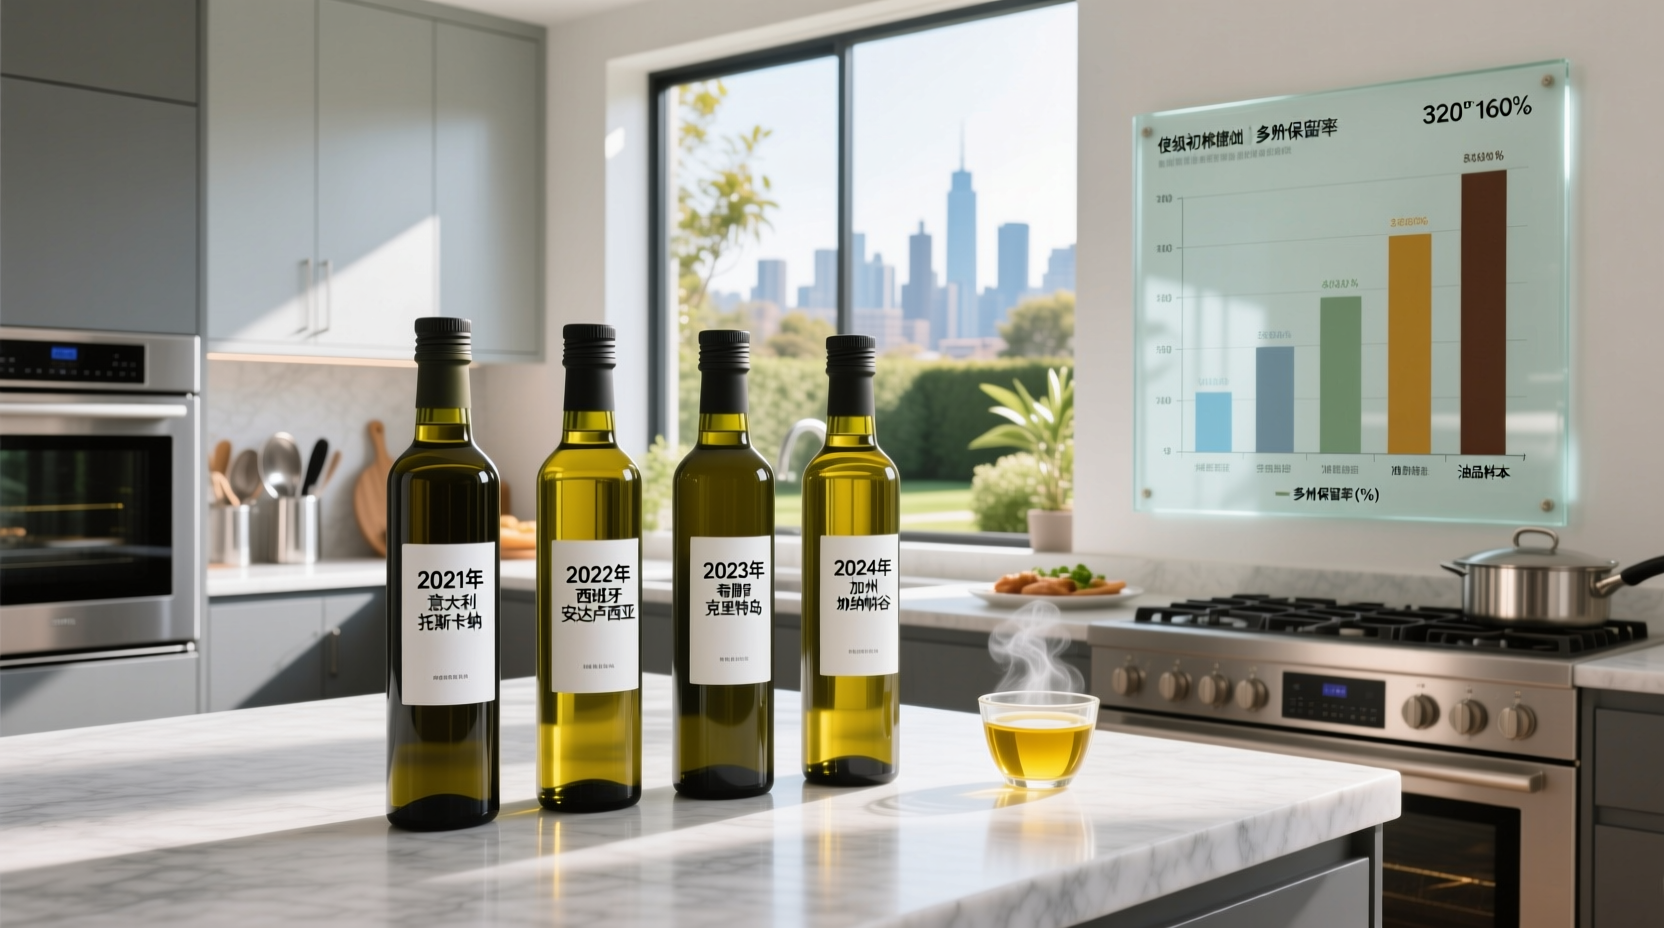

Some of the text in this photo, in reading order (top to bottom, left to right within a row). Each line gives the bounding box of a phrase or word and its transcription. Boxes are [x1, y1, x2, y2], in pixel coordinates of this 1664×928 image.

[566, 564, 630, 583] 2022年
[704, 561, 764, 579] 2023年
[834, 558, 891, 576] 2024年
[418, 568, 483, 589] 2021年
